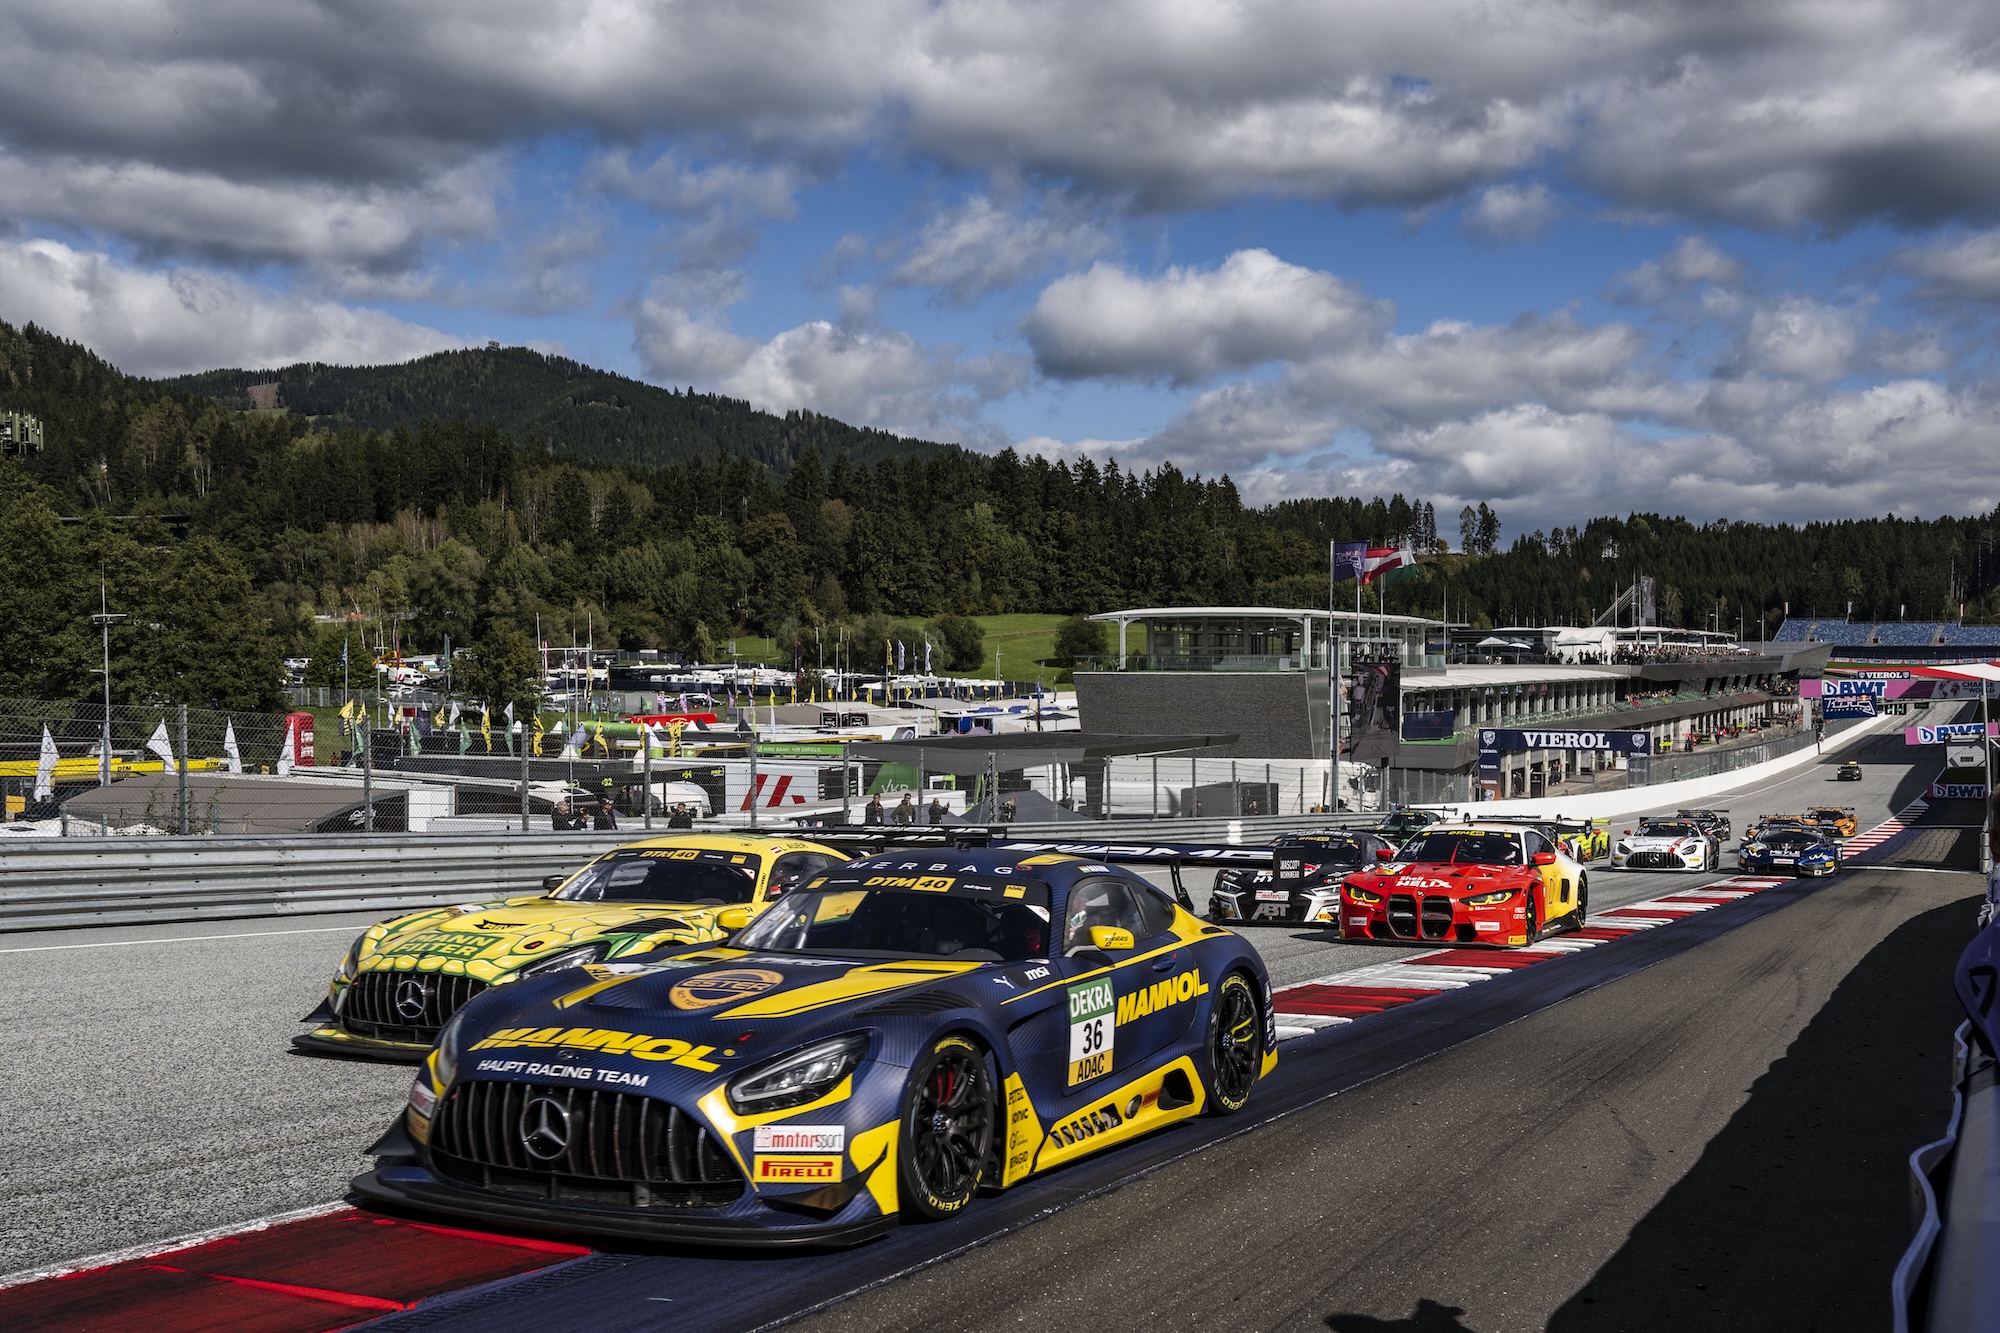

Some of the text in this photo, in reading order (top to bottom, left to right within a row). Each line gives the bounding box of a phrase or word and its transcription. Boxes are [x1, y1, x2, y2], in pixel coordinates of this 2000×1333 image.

[1866, 671, 1903, 679] VIEROL
[1839, 681, 1886, 697] BWT
[1522, 731, 1610, 749] VIEROL
[1947, 785, 1984, 798] BWT
[639, 850, 695, 859] DTM 40
[846, 861, 1014, 875] MERBAG
[1280, 860, 1299, 870] MASCOT
[863, 876, 948, 889] DTM 40
[1396, 878, 1453, 888] HELIX
[1251, 903, 1291, 920] ABT
[408, 932, 498, 947] MANN
[394, 941, 480, 957] FILTER
[1024, 966, 1050, 981] msi
[681, 979, 773, 991] ESTER
[1070, 983, 1114, 1018] DEKRA
[1082, 1019, 1103, 1054] 36
[467, 1027, 721, 1073] MANNOL
[476, 1060, 650, 1088] HAUPT RACING TEAM
[1076, 1053, 1105, 1082] ADAC
[772, 1132, 842, 1149] motorsport
[761, 1160, 834, 1177] PIRELLI
[928, 1195, 961, 1212] ZERO
